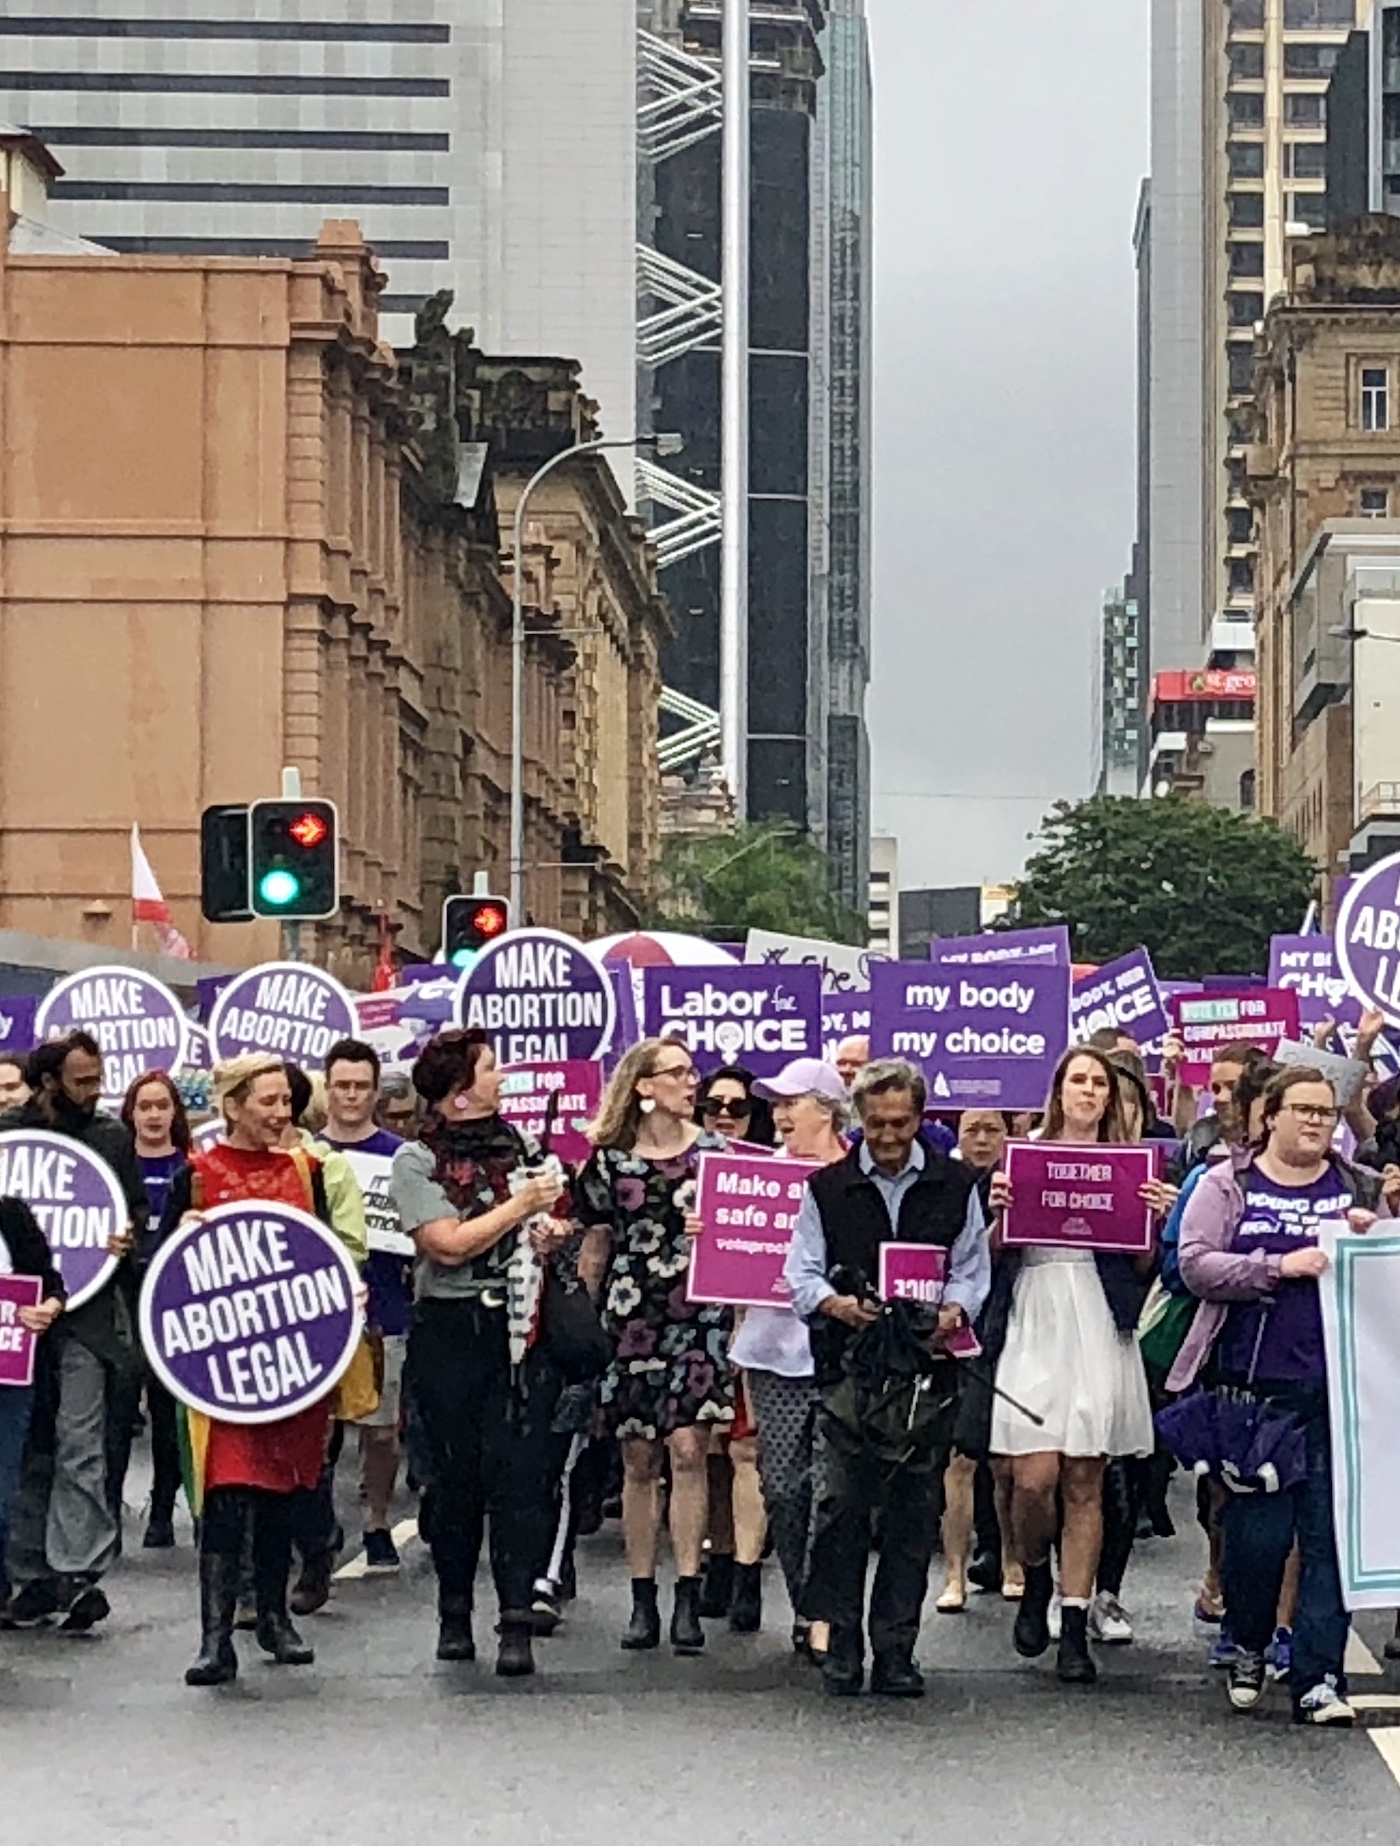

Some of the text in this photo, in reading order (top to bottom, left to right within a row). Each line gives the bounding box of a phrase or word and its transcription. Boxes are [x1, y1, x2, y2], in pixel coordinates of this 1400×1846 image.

[495, 943, 573, 988] MAKE
[1280, 951, 1311, 967] MY
[70, 978, 146, 1020] MAKE
[253, 974, 331, 1022] MAKE
[467, 991, 602, 1029] ABORTION
[661, 984, 768, 1016] Labor
[906, 981, 1035, 1013] my body
[1240, 1000, 1267, 1016] FOR
[1070, 984, 1157, 1045] HOICE
[661, 1018, 807, 1054] CHOICE
[893, 1026, 1046, 1057] my choice
[716, 1172, 781, 1198] Make
[1046, 1162, 1113, 1182] TOGETHER
[1041, 1190, 1067, 1207] FOR
[715, 1206, 768, 1228] safe
[182, 1219, 294, 1295] MAKE
[162, 1266, 347, 1358] ABORTION
[207, 1331, 322, 1404] LEGAL
